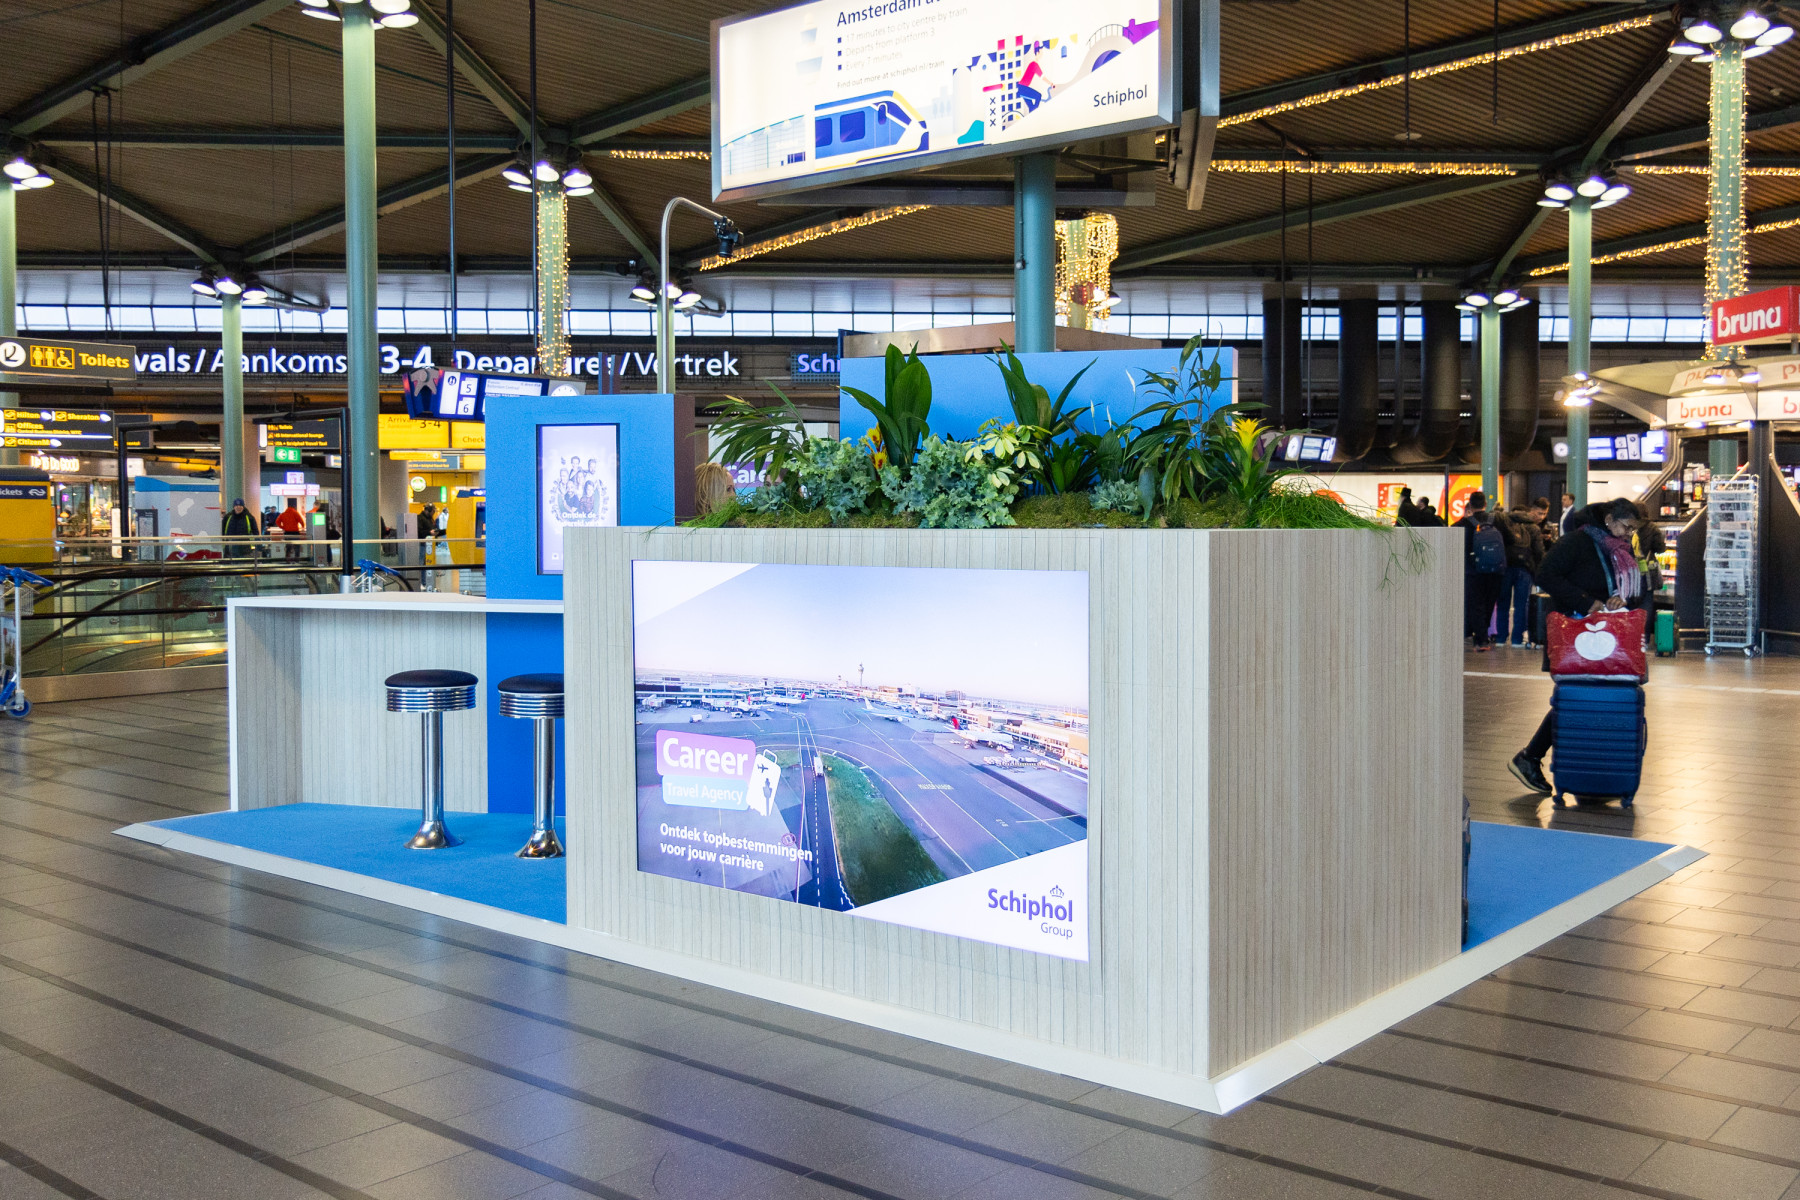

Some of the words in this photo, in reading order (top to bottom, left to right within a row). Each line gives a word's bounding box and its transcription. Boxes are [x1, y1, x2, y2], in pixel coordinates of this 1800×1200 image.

[837, 0, 921, 27] Amsterdam
[856, 27, 886, 39] minutes
[887, 25, 896, 33] to
[897, 22, 910, 32] city
[912, 16, 936, 27] centre
[938, 11, 948, 21] by
[949, 7, 968, 18] train
[846, 43, 874, 57] Departs
[875, 39, 893, 49] from
[895, 30, 929, 47] platform
[930, 27, 936, 37] 3
[846, 59, 865, 71] Every
[873, 51, 903, 63] minutes
[837, 80, 851, 88] Find
[852, 77, 863, 86] out
[864, 74, 881, 84] more
[882, 72, 889, 80] at
[1093, 84, 1148, 107] Schiphol
[1717, 306, 1781, 338] bruna
[79, 353, 130, 369] Toilets
[135, 347, 191, 372] vals
[210, 347, 348, 373] Aankoms
[380, 346, 435, 373] 3-4
[632, 350, 738, 375] Vrtrek
[798, 353, 841, 373] Schi
[465, 383, 472, 394] 5
[16, 411, 40, 420] Hilton
[67, 412, 100, 421] Sheraton
[463, 404, 469, 413] 6
[1680, 402, 1732, 418] bruna
[16, 422, 44, 431] Offices
[0, 487, 23, 496] ickets
[663, 738, 748, 776] Career
[666, 782, 699, 798] Travel
[701, 785, 743, 805] Agency
[660, 822, 701, 842] Ontdek
[703, 830, 813, 862] topbestemmingen
[660, 842, 685, 857] voor
[688, 844, 716, 861] jouw
[719, 849, 764, 871] carrière
[988, 888, 1073, 922] Schiphol
[1040, 922, 1073, 940] Group
